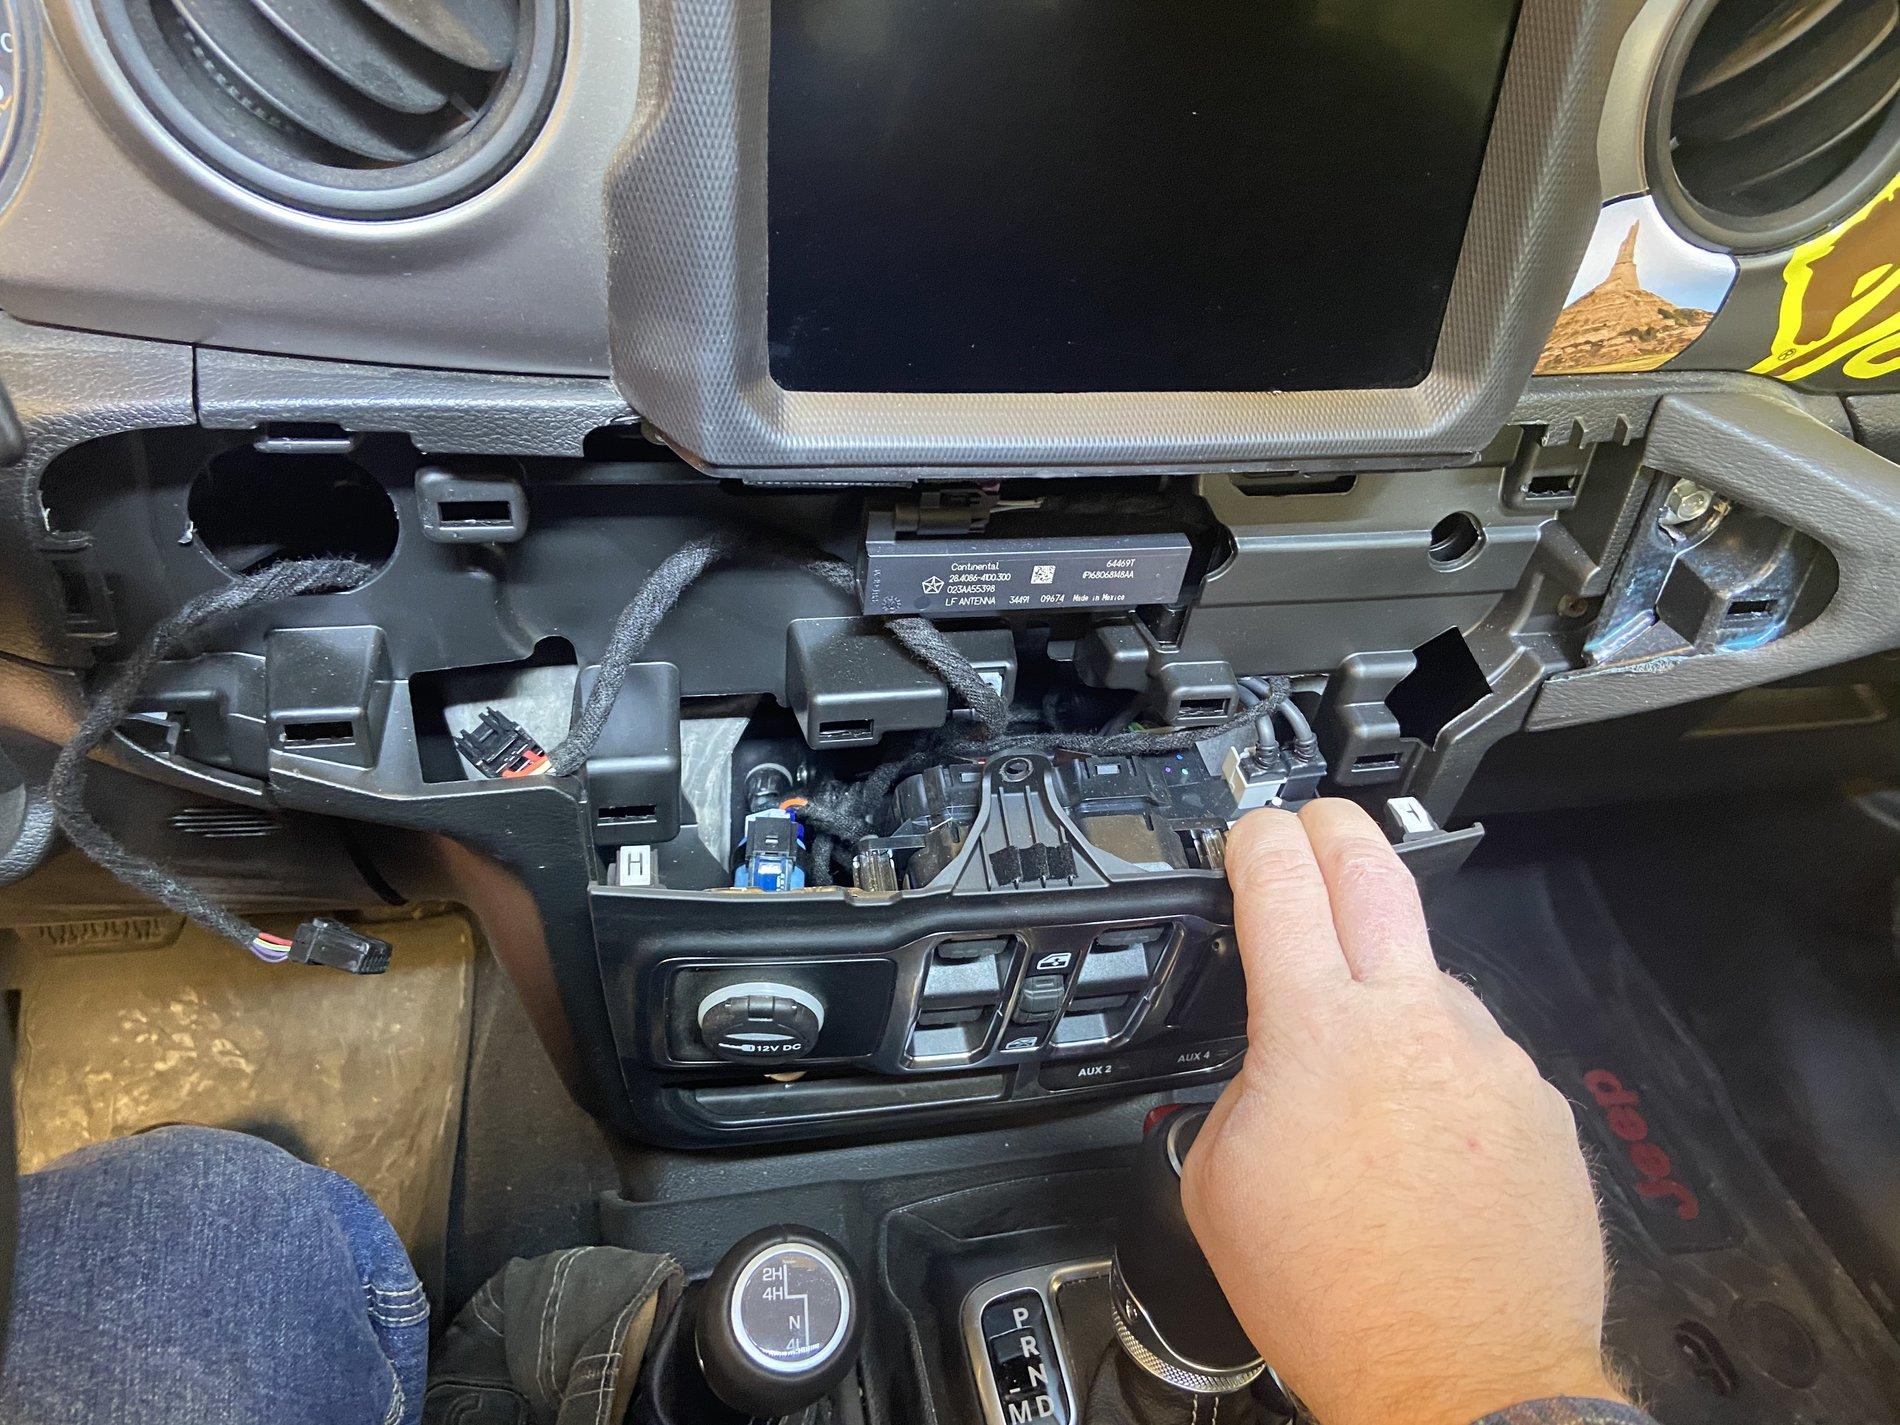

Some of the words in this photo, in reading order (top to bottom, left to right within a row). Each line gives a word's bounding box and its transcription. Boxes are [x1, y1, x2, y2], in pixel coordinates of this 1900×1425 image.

[951, 562, 999, 571] Continental
[1106, 559, 1136, 568] 64469T
[945, 598, 957, 606] LF
[959, 596, 996, 606] ANTENNA
[1040, 594, 1066, 602] 09674
[1073, 594, 1089, 602] Made
[1176, 1053, 1201, 1062] AUX
[1202, 1051, 1210, 1059] 4
[1078, 1066, 1102, 1077] AUX
[1104, 1065, 1112, 1074] 2
[762, 1267, 783, 1281] 2H
[762, 1286, 783, 1300] 4H
[789, 1316, 800, 1330] N
[1013, 1308, 1028, 1328] P
[1020, 1336, 1040, 1357] R
[1028, 1364, 1048, 1387] N
[1008, 1400, 1032, 1425] M
[1035, 1394, 1055, 1418] D
